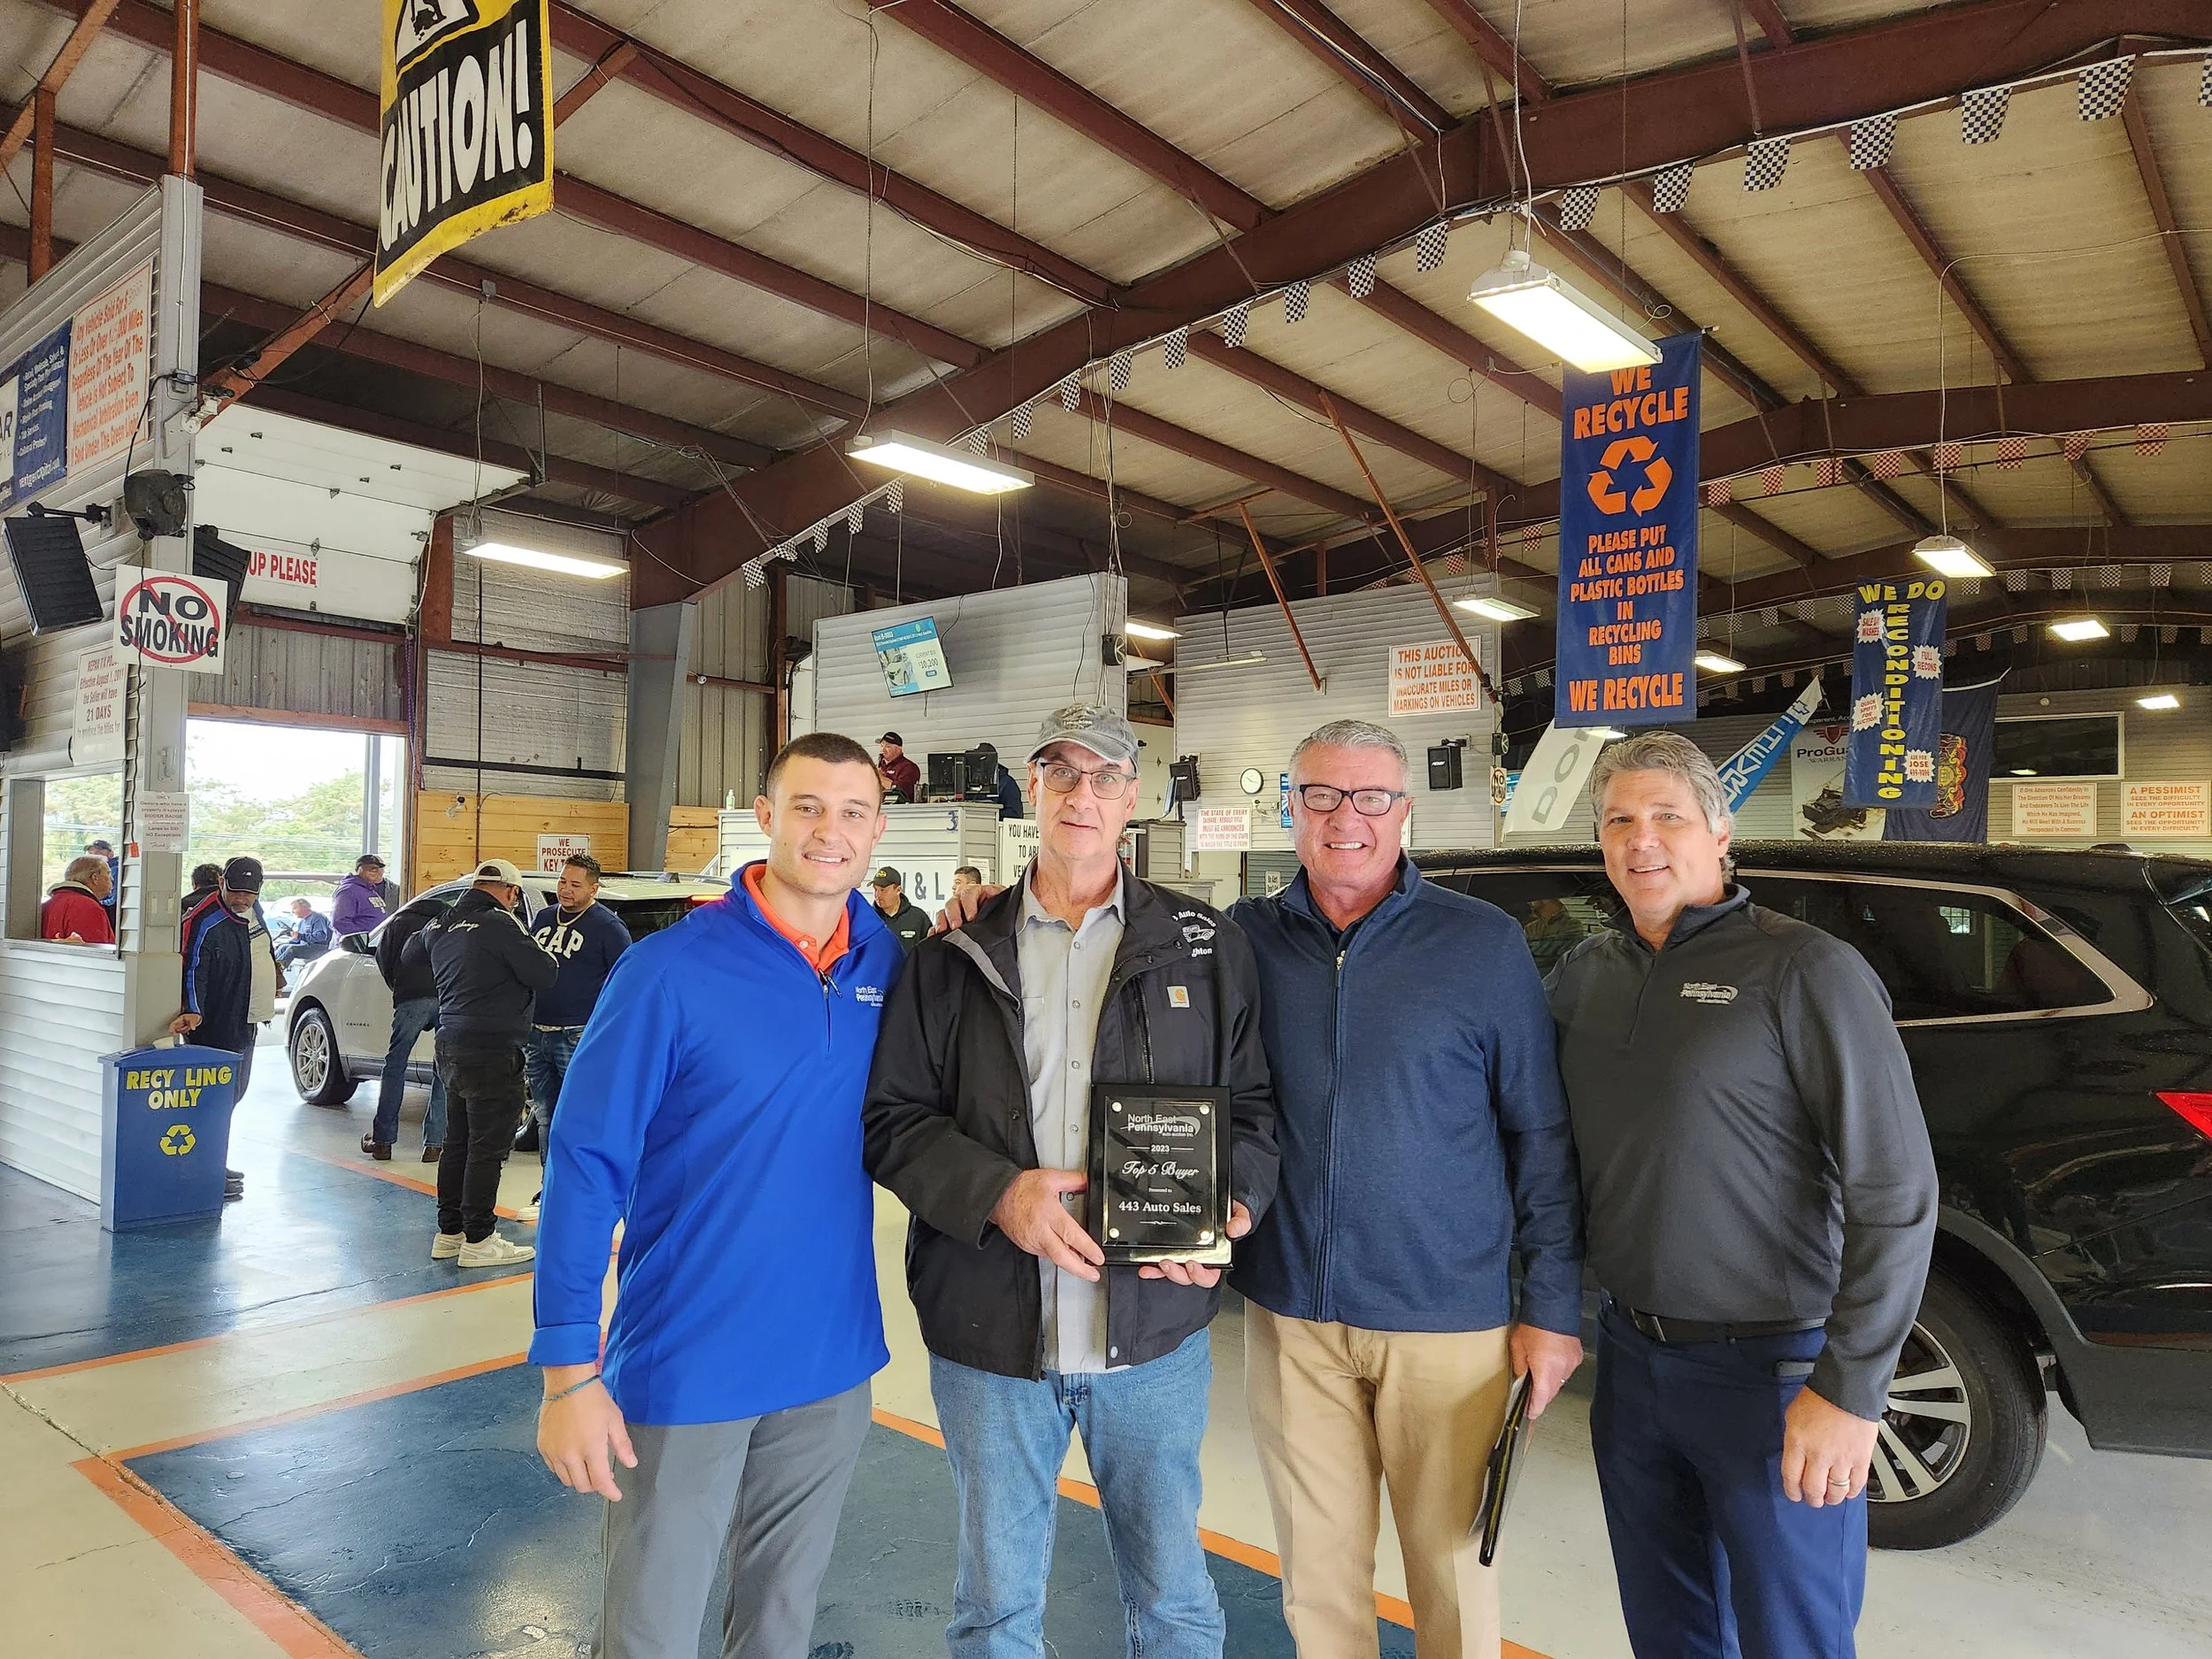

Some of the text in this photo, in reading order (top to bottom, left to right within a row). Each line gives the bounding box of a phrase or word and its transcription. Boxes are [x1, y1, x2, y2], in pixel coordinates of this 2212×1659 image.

[380, 19, 533, 251] CAUTION!
[1609, 365, 1651, 396] WE
[1573, 386, 1689, 440] RECYCLE
[1588, 525, 1667, 554] PLEASE PUT
[248, 551, 317, 585] UP PLEASE
[1578, 546, 1675, 578] ALL CANS AND
[1571, 569, 1685, 602] PLASTIC BOTTLES
[1858, 580, 1946, 604] WE DO
[138, 588, 208, 620] NO
[1617, 601, 1634, 620] IN
[119, 615, 219, 657] SMOKING
[1588, 619, 1663, 646] RECYCLING
[1398, 649, 1421, 664] THIS
[1609, 643, 1641, 665] BINS
[1921, 651, 1933, 661] FULL
[96, 672, 110, 687] August
[1394, 661, 1474, 680] IS NOT LIABLE FOR
[1396, 679, 1472, 696] INACCURATE MILES OR
[1569, 672, 1684, 712] WE RECYCLE
[1394, 693, 1475, 712] MARKINGS ON VEHICLES
[1878, 603, 1912, 799] RECONDITIONING
[87, 704, 111, 722] 21 DAYS
[2141, 786, 2202, 795] PESSIMIST
[1009, 824, 1040, 839] YOU HAVE
[541, 848, 586, 856] PROSECUTE
[558, 838, 570, 847] WE
[1018, 844, 1026, 858] TO
[543, 858, 559, 872] KEY
[1178, 910, 1217, 927] Auto Sales
[534, 926, 584, 959] GAP
[1679, 989, 1732, 1000] Pennsylvania
[126, 1066, 233, 1090] RECY LING
[148, 1088, 203, 1110] ONLY
[1127, 1113, 1177, 1124] North East
[1127, 1122, 1194, 1134] Pennsylvania
[1150, 1144, 1170, 1153] 2023
[1121, 1161, 1200, 1179] Top 5 Buyer
[1118, 1201, 1202, 1213] 443 Auto Sales
